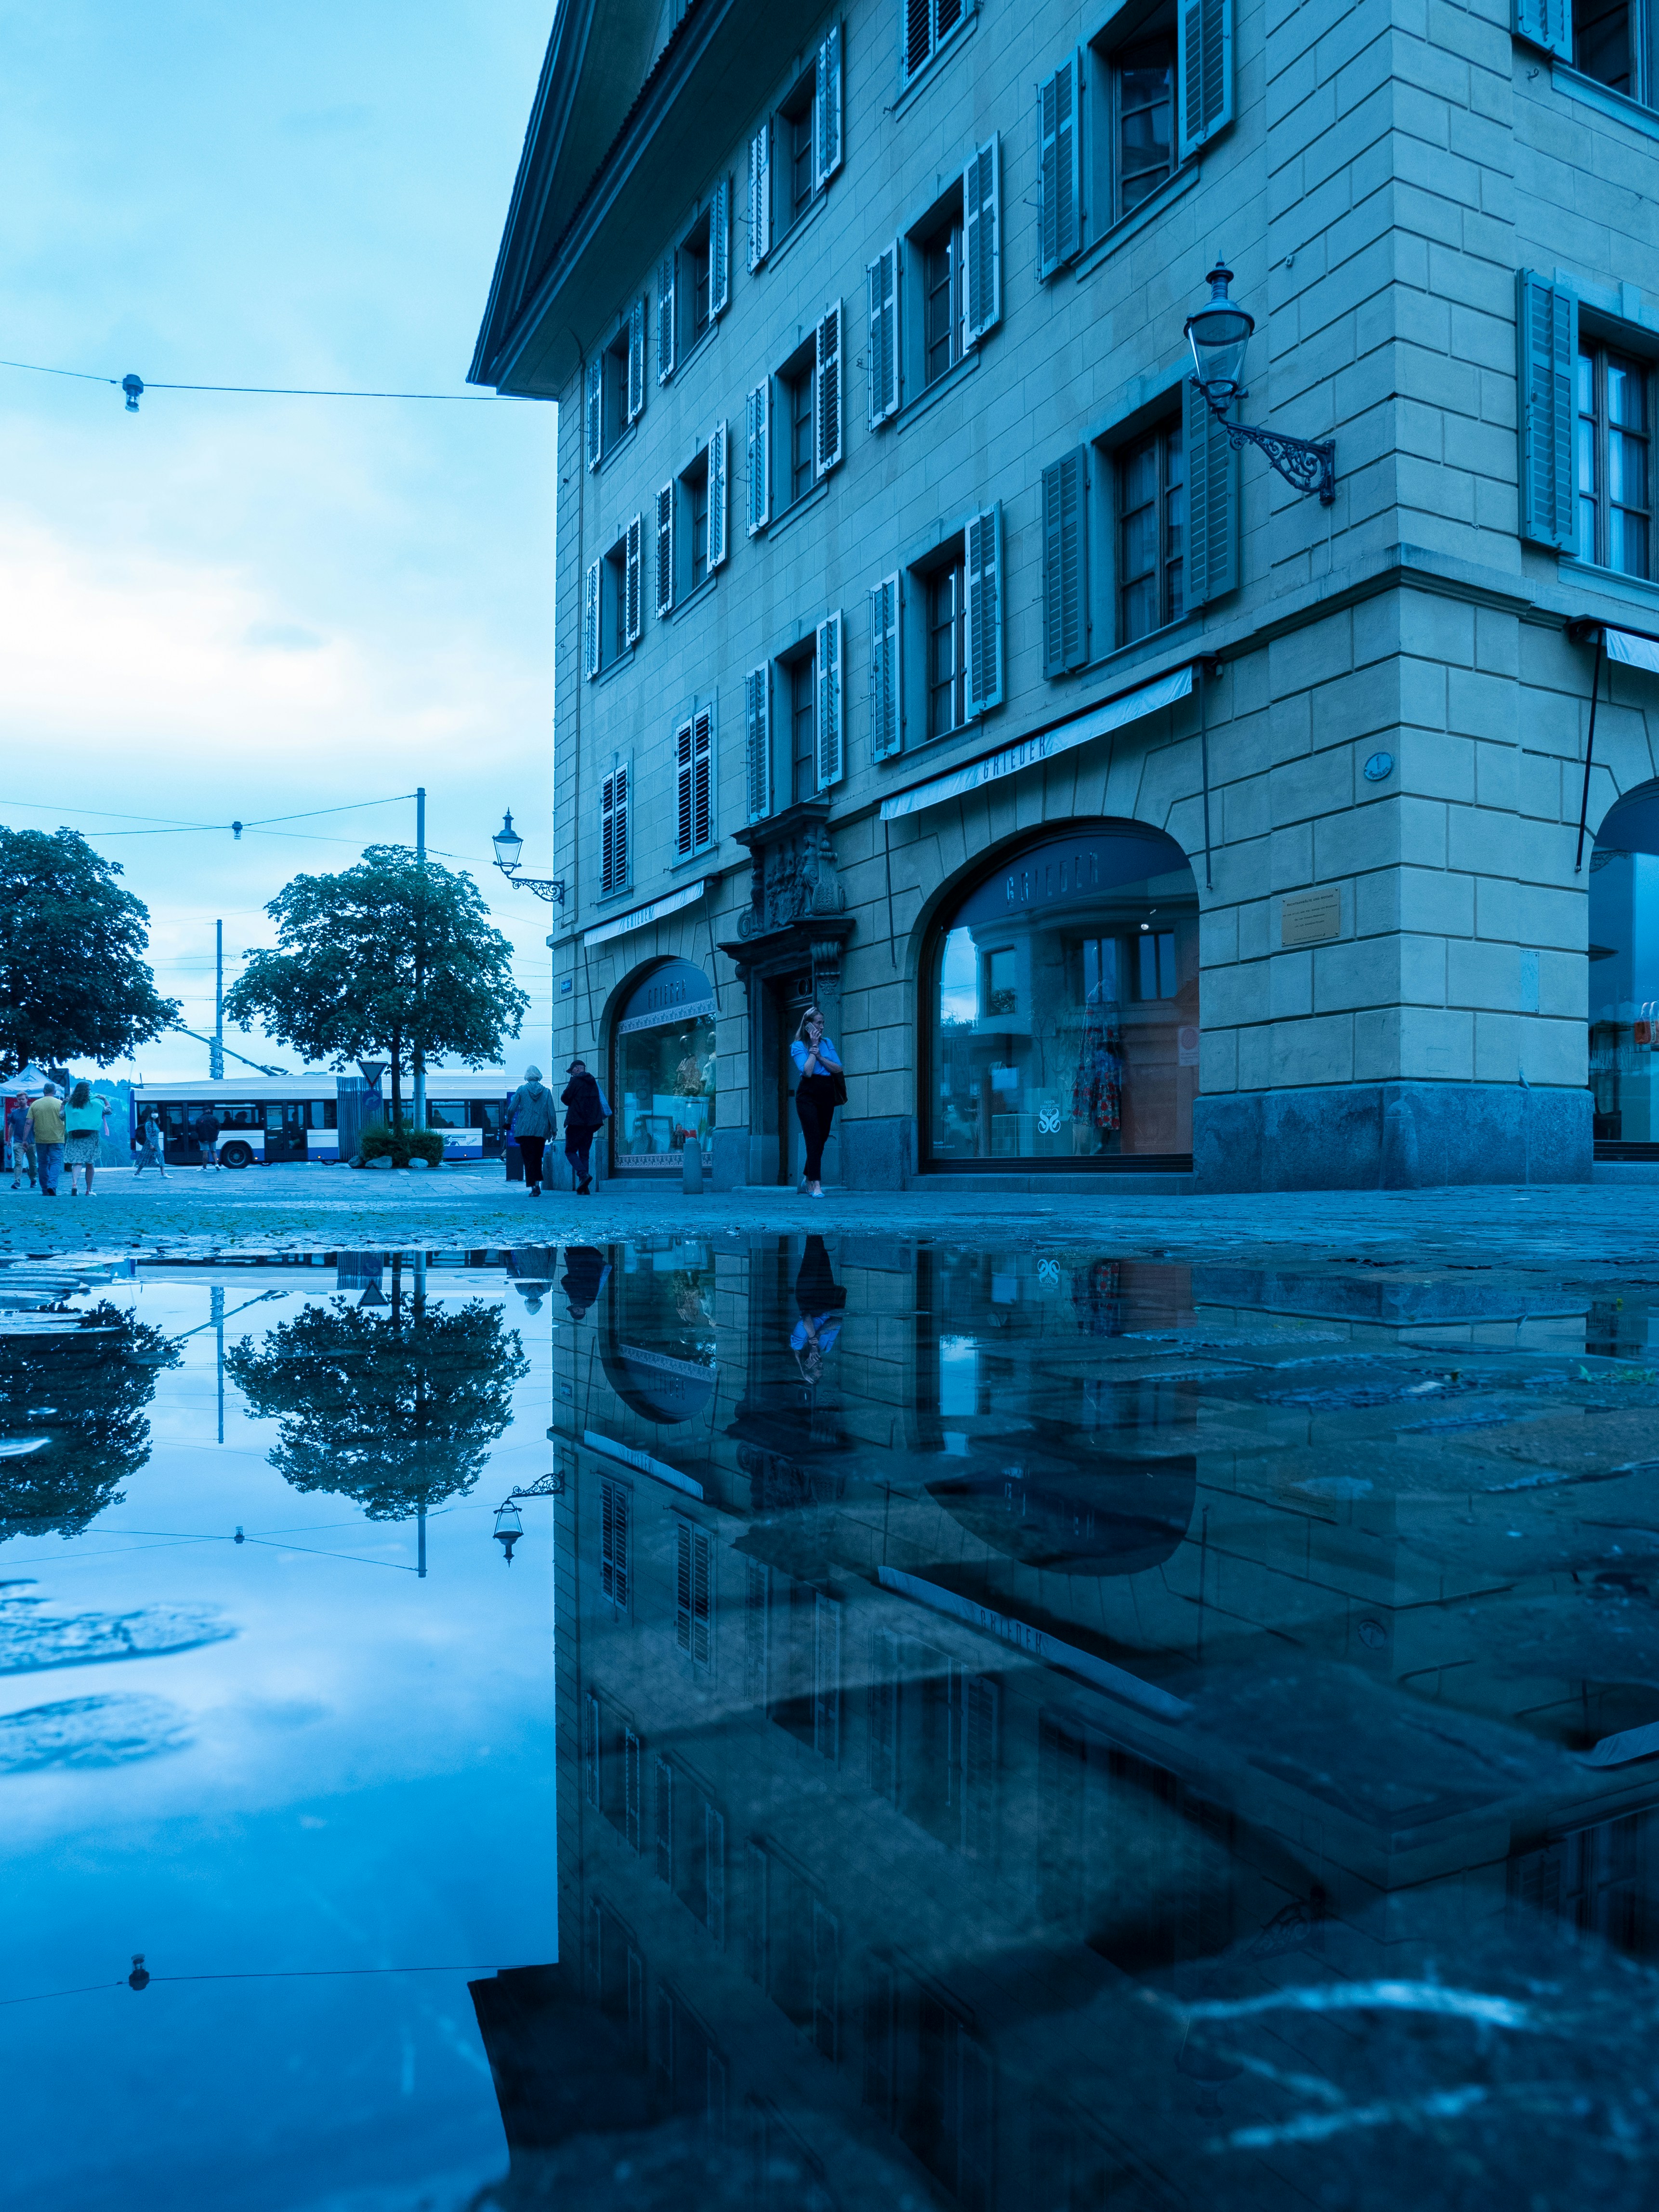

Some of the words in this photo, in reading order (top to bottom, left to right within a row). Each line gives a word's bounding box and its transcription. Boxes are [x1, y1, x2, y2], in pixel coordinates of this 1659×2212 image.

[983, 735, 1045, 779] GRIEDER
[1007, 852, 1098, 908] GRIEDER
[626, 906, 653, 929] GRIEDER
[648, 979, 686, 1010] GRIEDER
